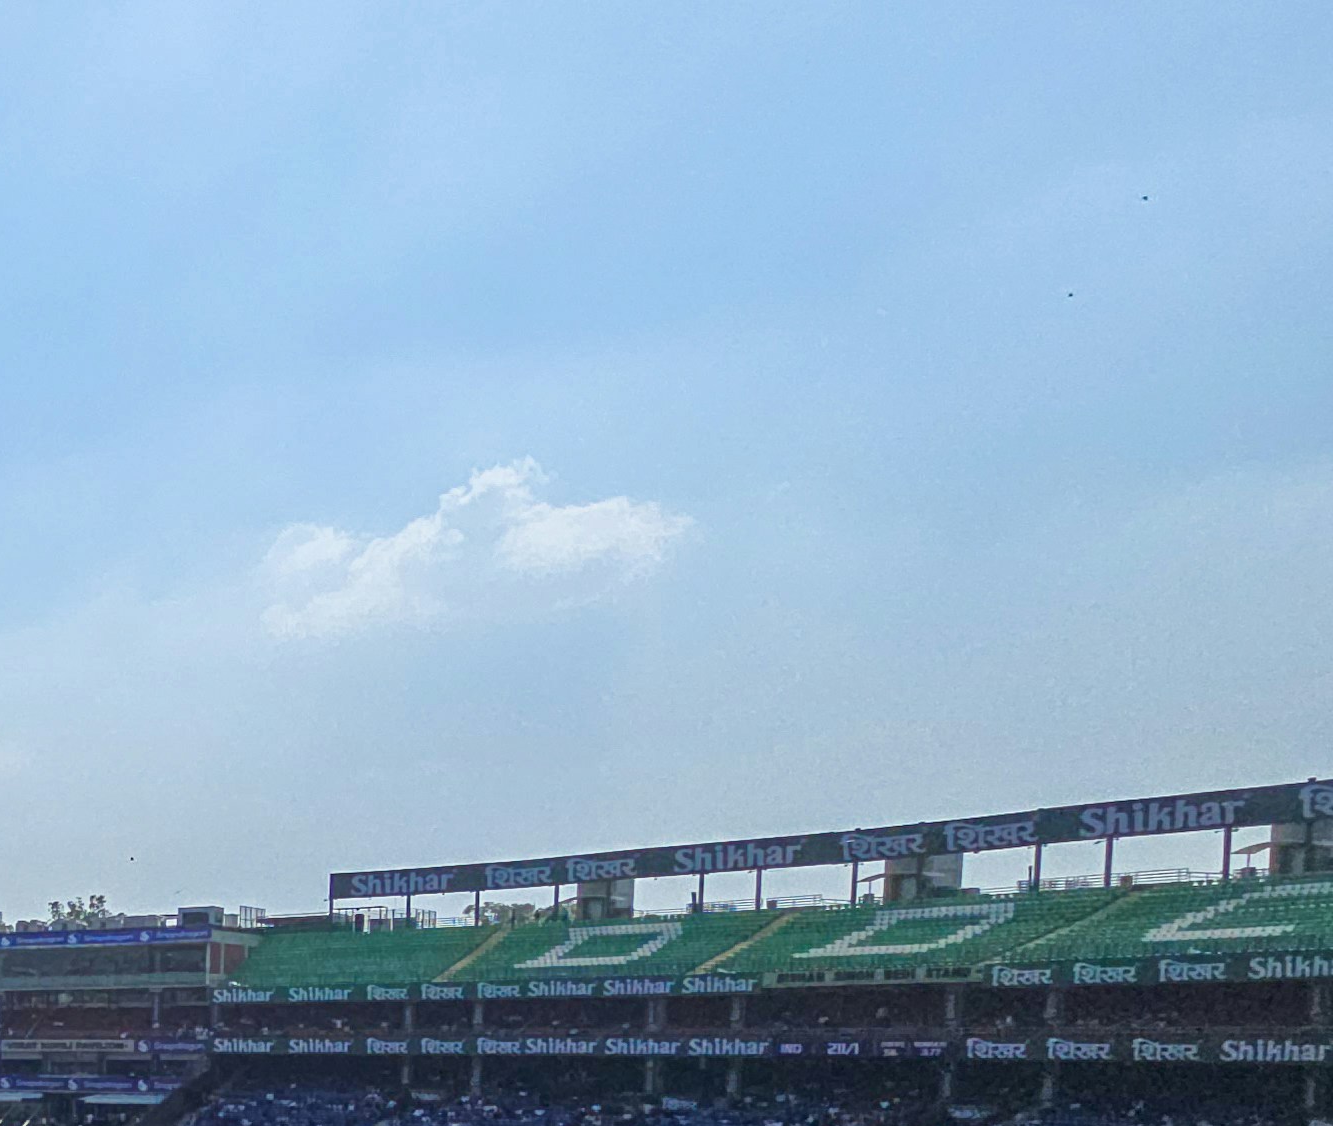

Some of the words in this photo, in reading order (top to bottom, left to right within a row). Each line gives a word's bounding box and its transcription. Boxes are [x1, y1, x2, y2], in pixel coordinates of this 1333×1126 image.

[1079, 799, 1246, 839] Shikhar
[943, 820, 1037, 851] शिखर
[840, 832, 926, 861] शिखर
[566, 857, 638, 881] शिखर
[673, 843, 802, 874] Shikhar
[350, 871, 455, 895] Shikhar
[484, 865, 553, 887] शिखर
[992, 966, 1053, 986] शिखर
[1073, 963, 1137, 983] शिखर
[1158, 959, 1227, 982] शिखर
[213, 988, 274, 1003] Shikhar
[288, 986, 352, 1001] Shikhar
[528, 981, 594, 997] Shikhar
[603, 979, 676, 996] Shikhar
[683, 976, 758, 994] Shikhar
[213, 1039, 275, 1053] Shikhar
[288, 1038, 351, 1053] Shikhar
[526, 1038, 598, 1054] Shikhar
[605, 1038, 681, 1055] Shikhar
[688, 1038, 769, 1056] Shikhar
[966, 1037, 1028, 1059] शिखर
[1047, 1037, 1111, 1060] शिखर
[1132, 1038, 1200, 1061] शिखर
[1219, 1039, 1328, 1062] Shikhar
